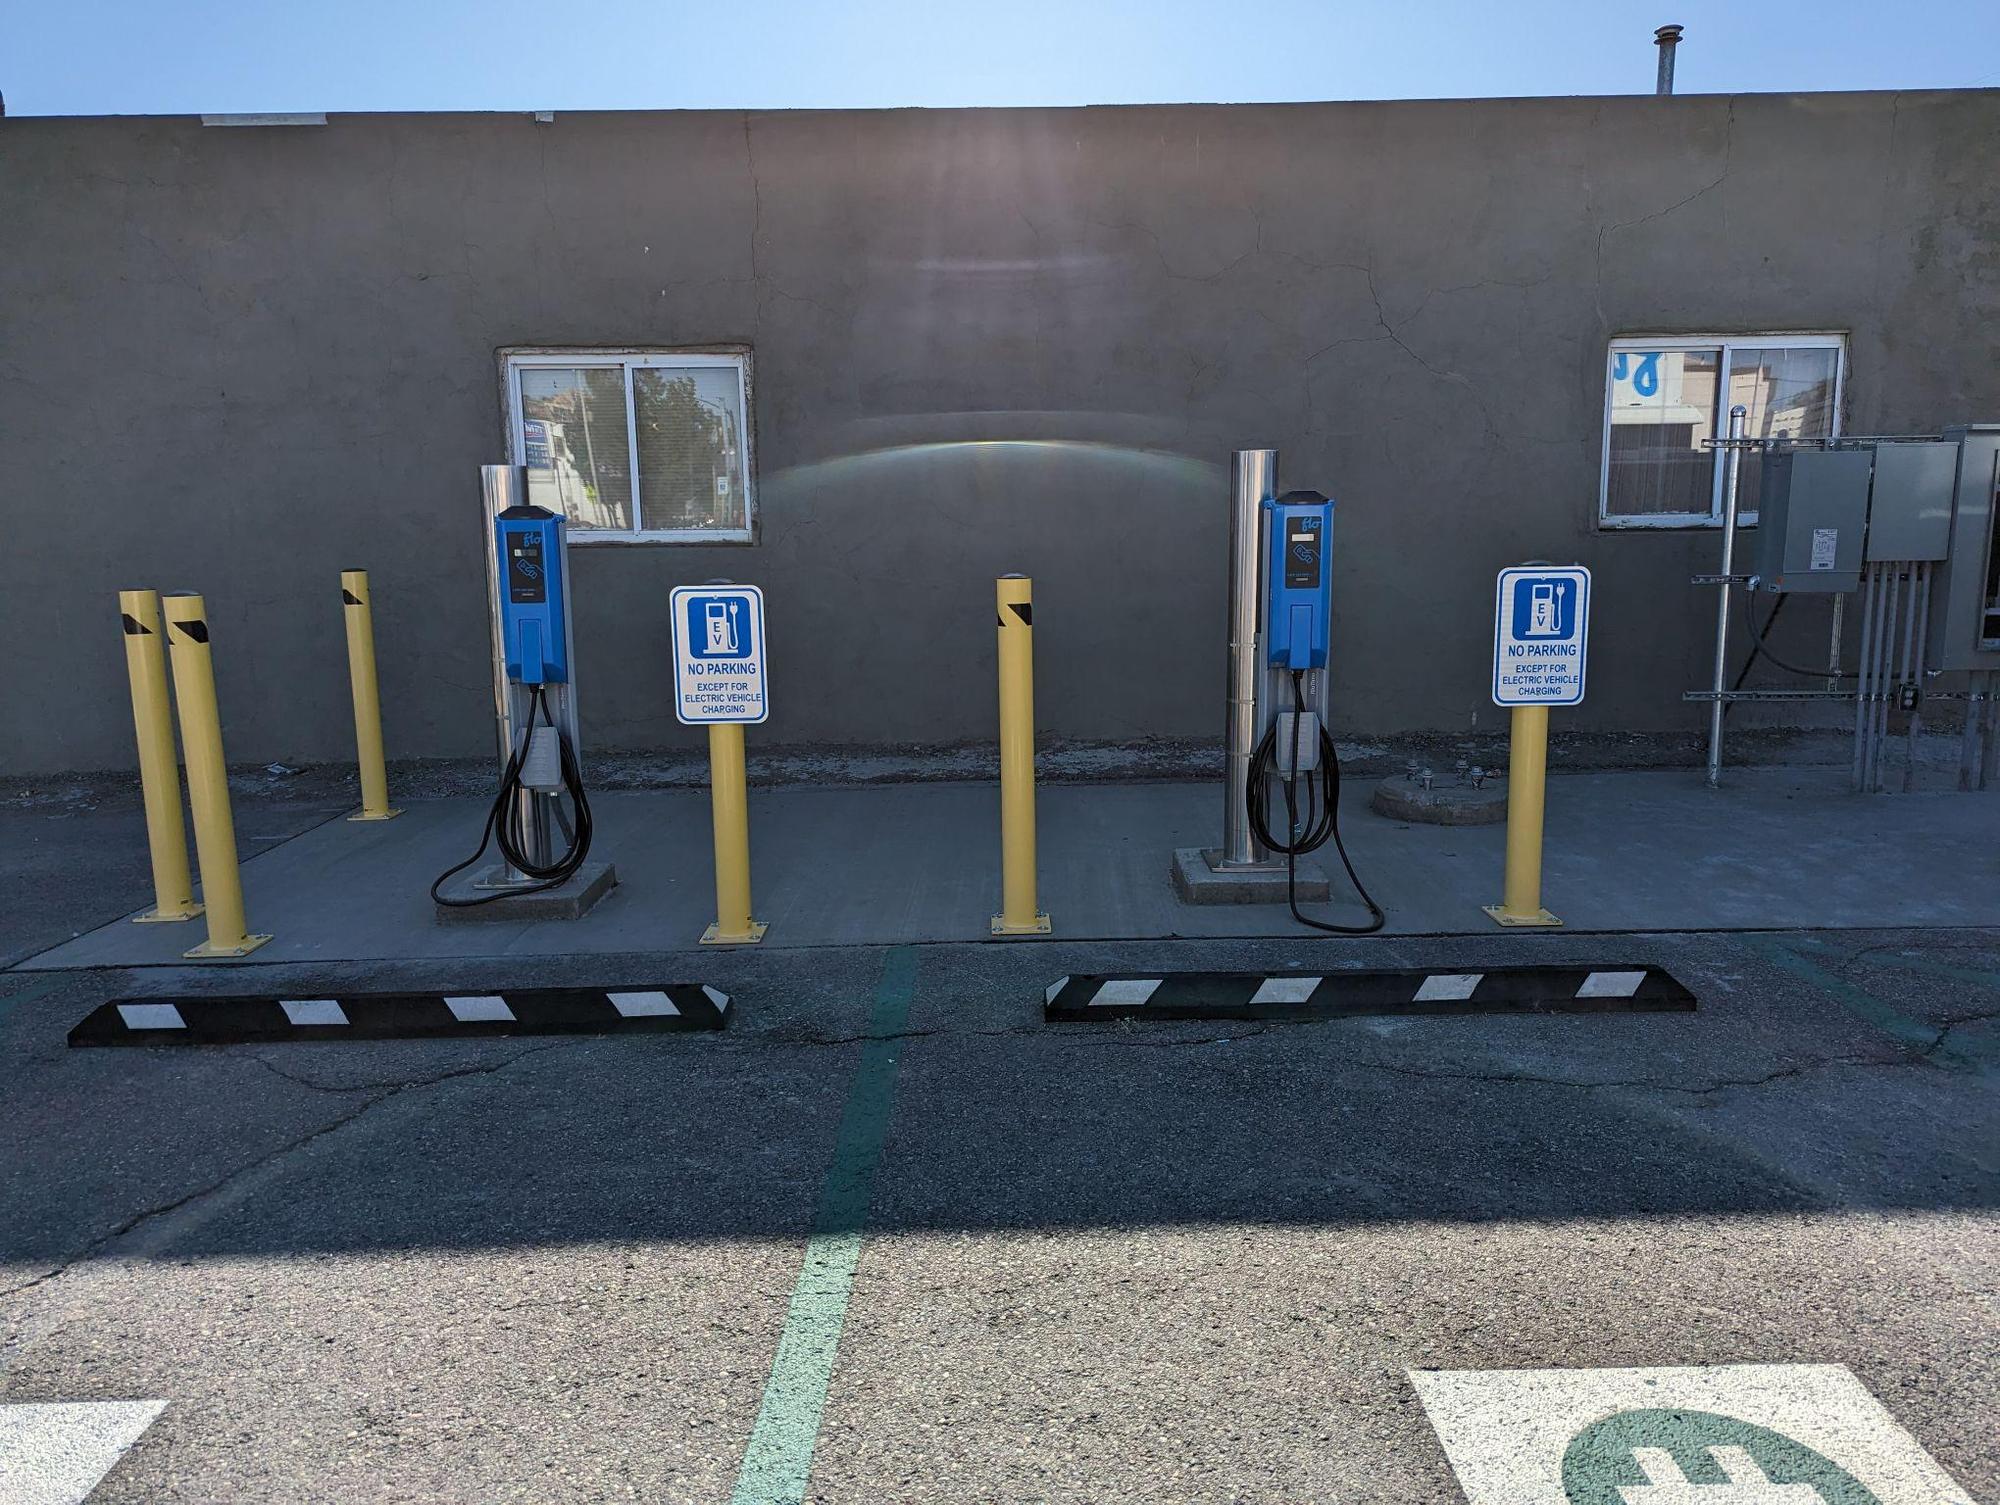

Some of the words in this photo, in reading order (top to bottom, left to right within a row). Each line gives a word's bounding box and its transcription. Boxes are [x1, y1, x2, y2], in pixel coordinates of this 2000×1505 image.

[1302, 517, 1321, 532] flo
[1508, 645, 1524, 657] NO
[1527, 644, 1577, 657] PARKING
[688, 663, 704, 675] NO
[707, 662, 756, 675] PARKING
[1515, 664, 1548, 673] EXCEPT
[1549, 664, 1567, 672] FOR
[1502, 676, 1542, 685] ELECTRIC
[1544, 675, 1579, 684] VEHICLE
[697, 682, 729, 691] EXCEPT
[731, 682, 748, 691] FOR
[1518, 687, 1562, 696] CHARGING
[685, 693, 725, 703] ELECTRIC
[726, 693, 761, 702] VEHICLE
[701, 704, 746, 714] CHARGING
